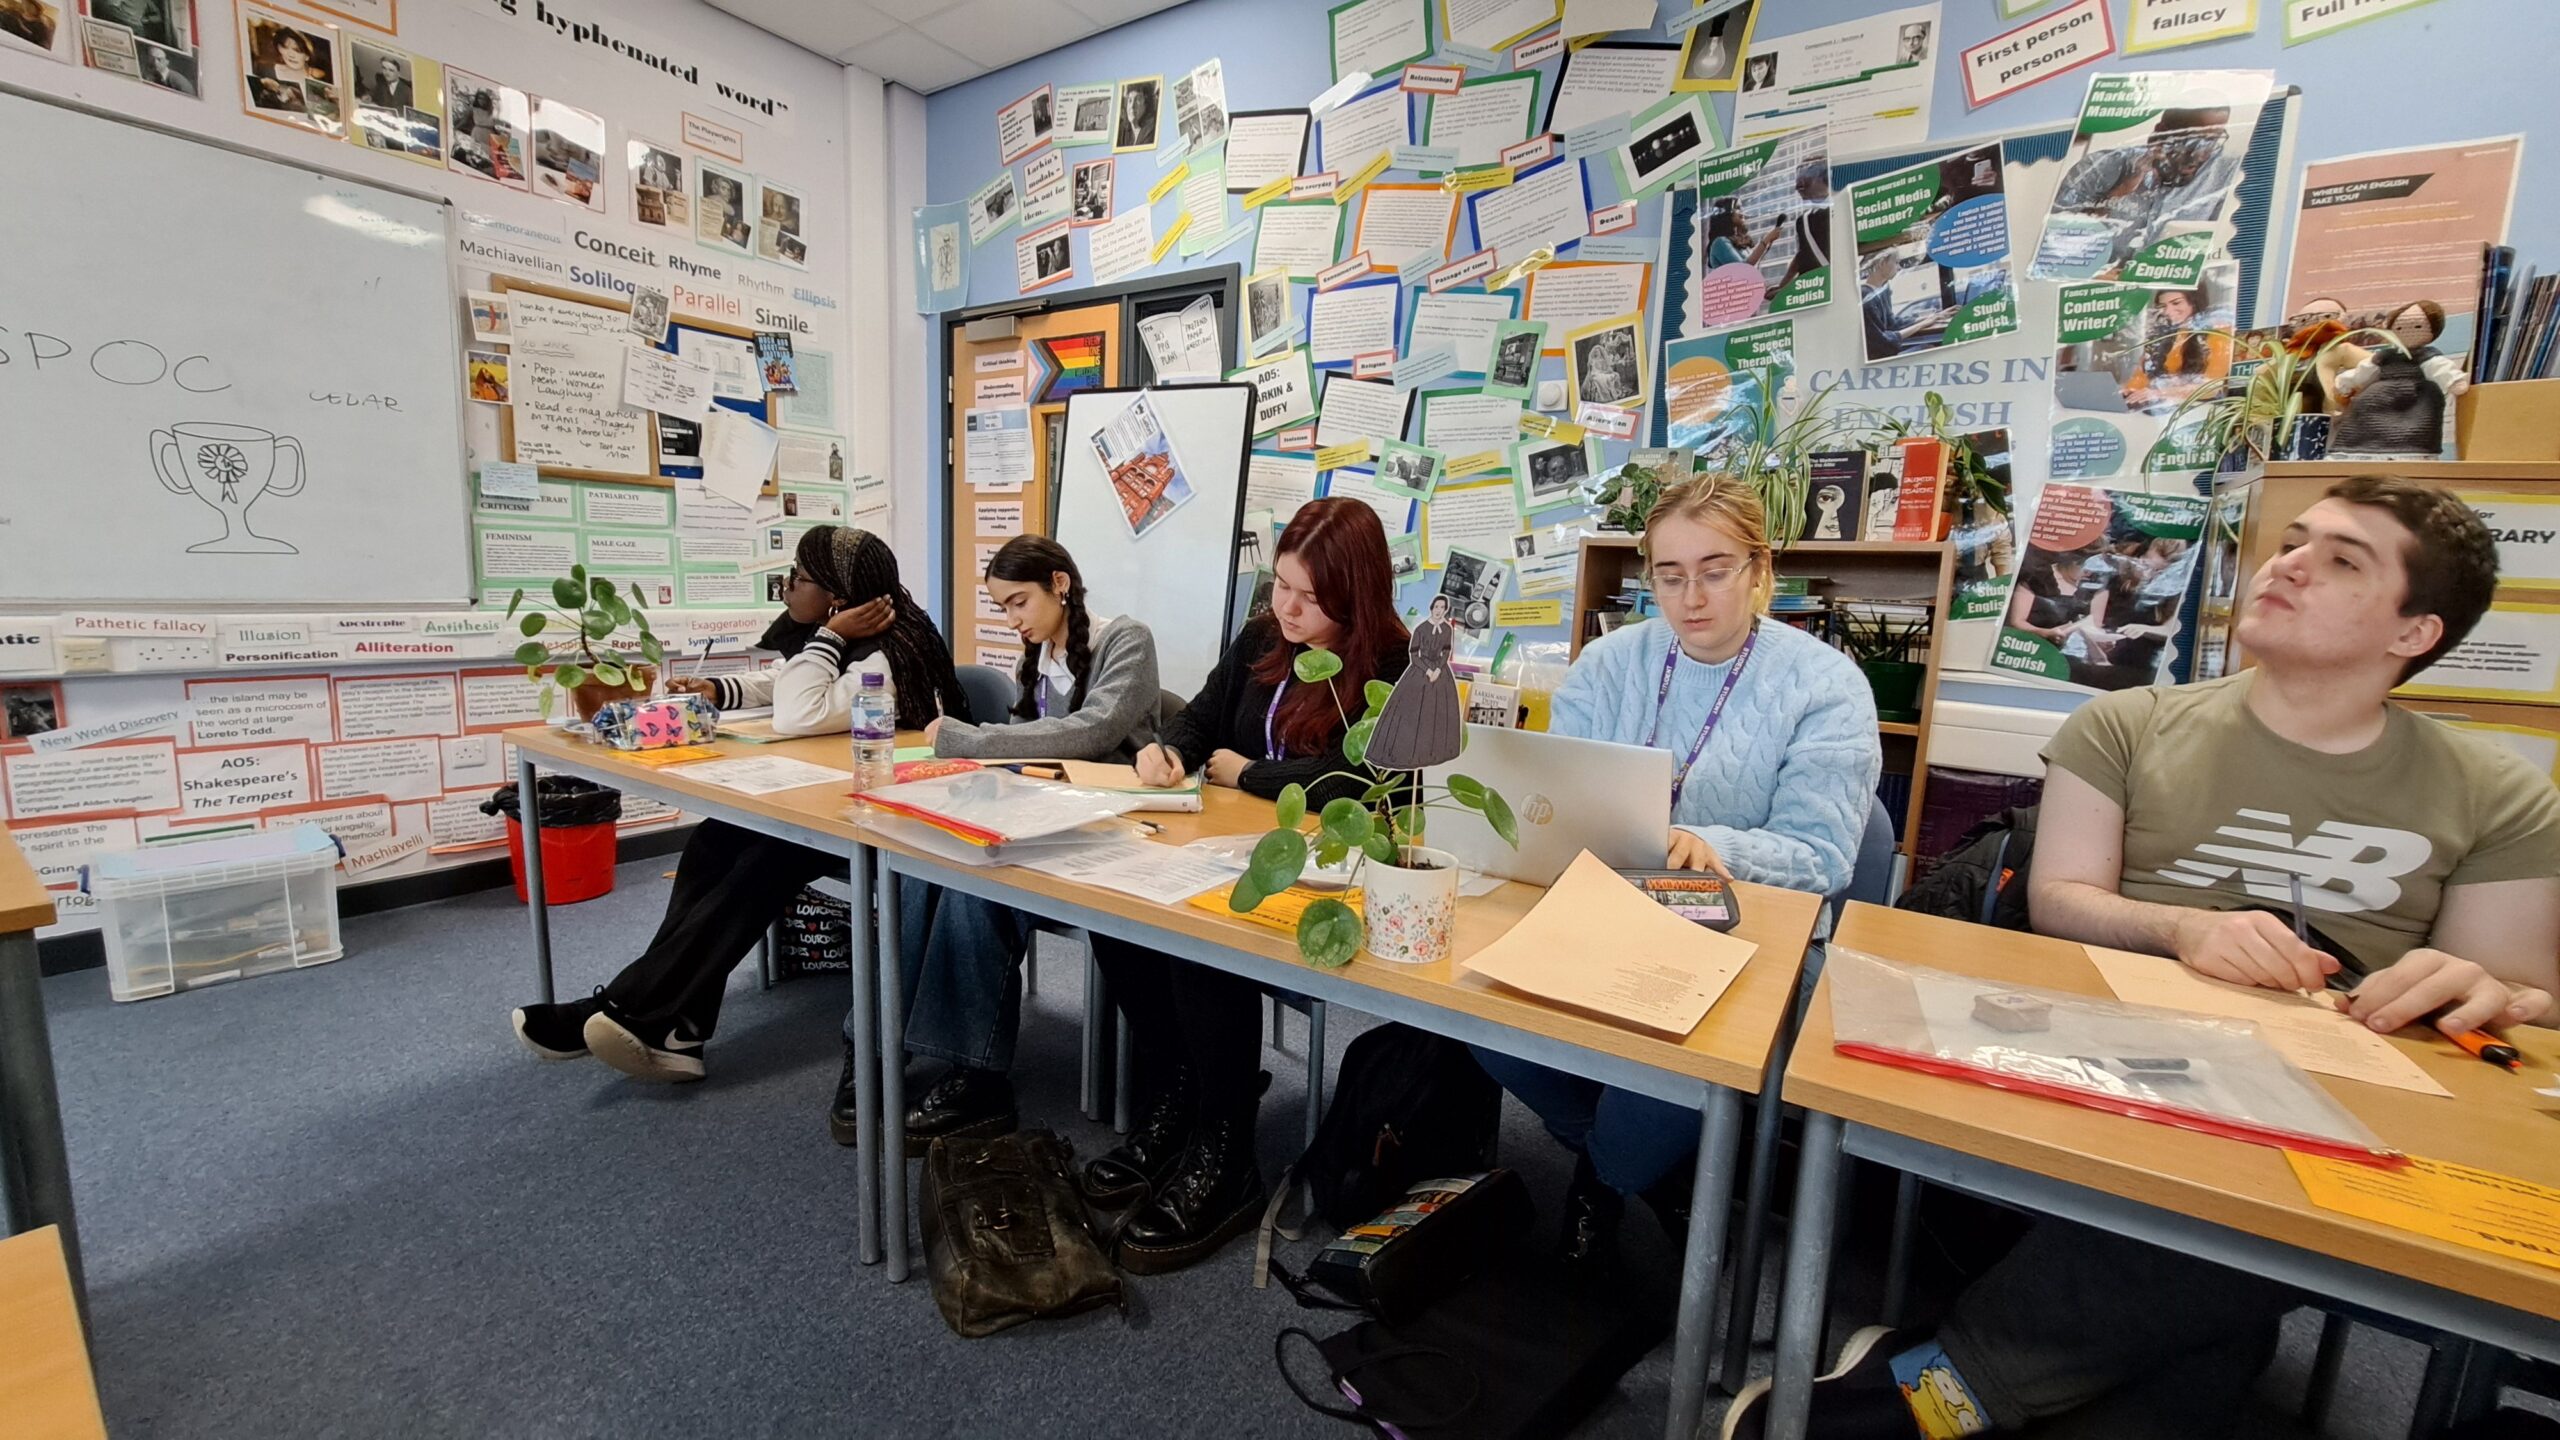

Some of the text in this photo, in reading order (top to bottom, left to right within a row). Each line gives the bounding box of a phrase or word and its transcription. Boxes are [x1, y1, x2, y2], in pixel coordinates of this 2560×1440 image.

[2152, 8, 2226, 30] fallacy
[536, 0, 698, 85] hyphenated
[1976, 12, 2093, 67] First person
[1999, 42, 2077, 83] persona
[1855, 187, 1876, 199] Fancy
[1877, 179, 1906, 194] yourself
[2312, 178, 2410, 197] WHERE CAN ENGLISH
[1856, 188, 1932, 218] Social Media
[1600, 213, 1624, 225] Death
[1857, 207, 1914, 231] Manager?
[460, 238, 563, 274] Machiavellian
[574, 230, 657, 268] Conceit
[2155, 244, 2197, 261] Study
[668, 254, 722, 280] Rhyme
[1435, 270, 1462, 285] Passage
[1472, 259, 1488, 271] time
[2135, 261, 2193, 280] English
[738, 273, 785, 297] Rhythm
[1795, 275, 1825, 291] Study
[673, 284, 741, 317] Parallel
[793, 287, 838, 310] Ellipsis
[1786, 288, 1825, 306] English
[2064, 288, 2089, 298] Fancy
[1973, 301, 2007, 318] Study
[2064, 297, 2121, 316] Content
[755, 307, 809, 334] Simile
[1963, 315, 2009, 334] English
[2063, 314, 2118, 333] Writer?
[1730, 335, 1749, 345] Fancy
[1752, 335, 1792, 354] Speech
[1809, 356, 2052, 394] CAREERS IN
[1260, 402, 1288, 422] DUFFY
[588, 491, 640, 501] PATRIARCHY
[480, 502, 530, 512] CRITICISM
[2133, 508, 2205, 528] Director?
[486, 532, 532, 542] FEMINISM
[591, 539, 637, 548] MALE GAZE
[75, 617, 207, 633] Pathetic fallacy
[336, 618, 406, 629] Apostrophe
[425, 619, 500, 633] Antithesis
[691, 618, 757, 634] Exaggeration
[239, 629, 301, 642] Illusion
[2001, 635, 2040, 655] Study
[226, 649, 339, 663] Personification
[355, 641, 454, 654] Alliteration
[1732, 647, 1750, 676] STUDENT
[1996, 652, 2047, 673] English
[1660, 665, 1673, 695] STUDENT
[232, 691, 308, 703] island may be
[1713, 686, 1730, 715] STUDENT
[196, 707, 224, 717] seen
[255, 702, 314, 713] microcosm
[40, 710, 179, 749] New World Discovery
[196, 719, 215, 728] the
[217, 716, 250, 726] world
[266, 714, 295, 725] large
[197, 730, 239, 740] Loreto
[1694, 725, 1711, 754] STUDENT
[192, 789, 295, 809] The Tempest
[31, 841, 64, 852] spirit
[84, 836, 105, 845] the
[351, 834, 424, 870] Machiavelli
